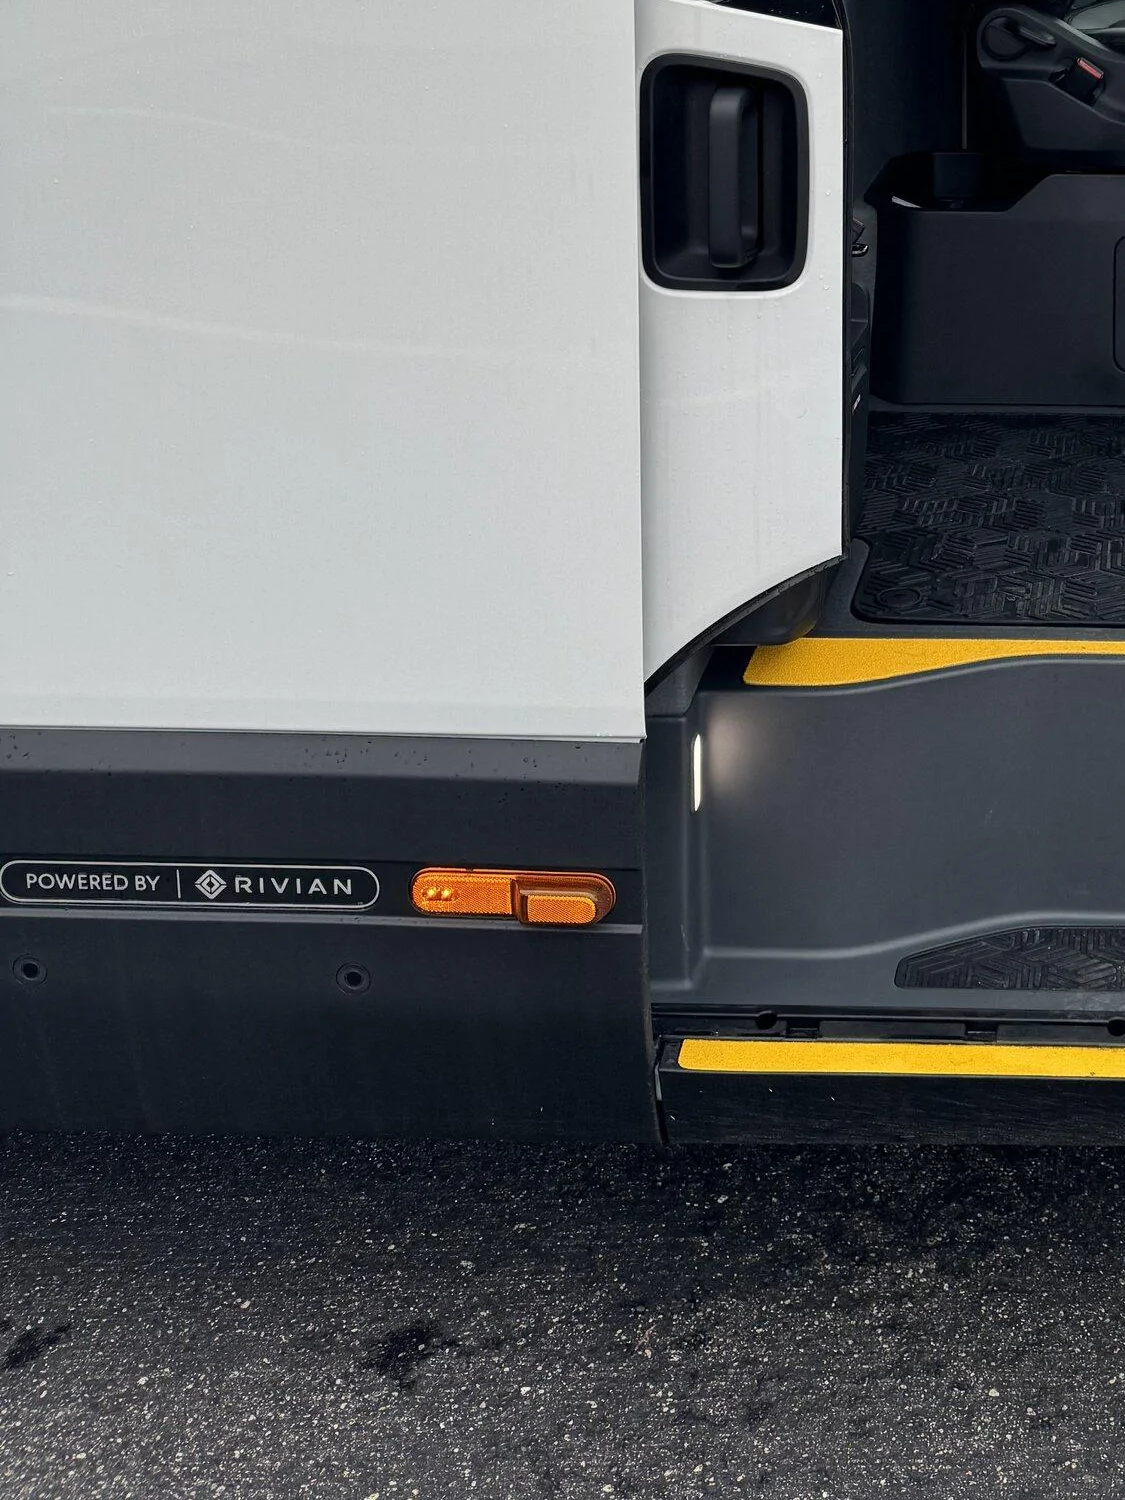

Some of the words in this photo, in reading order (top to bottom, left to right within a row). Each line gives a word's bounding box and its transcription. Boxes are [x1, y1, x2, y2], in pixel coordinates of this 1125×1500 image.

[26, 873, 129, 891] POWERED
[134, 875, 161, 892] BY
[234, 876, 352, 896] RIVIAN
